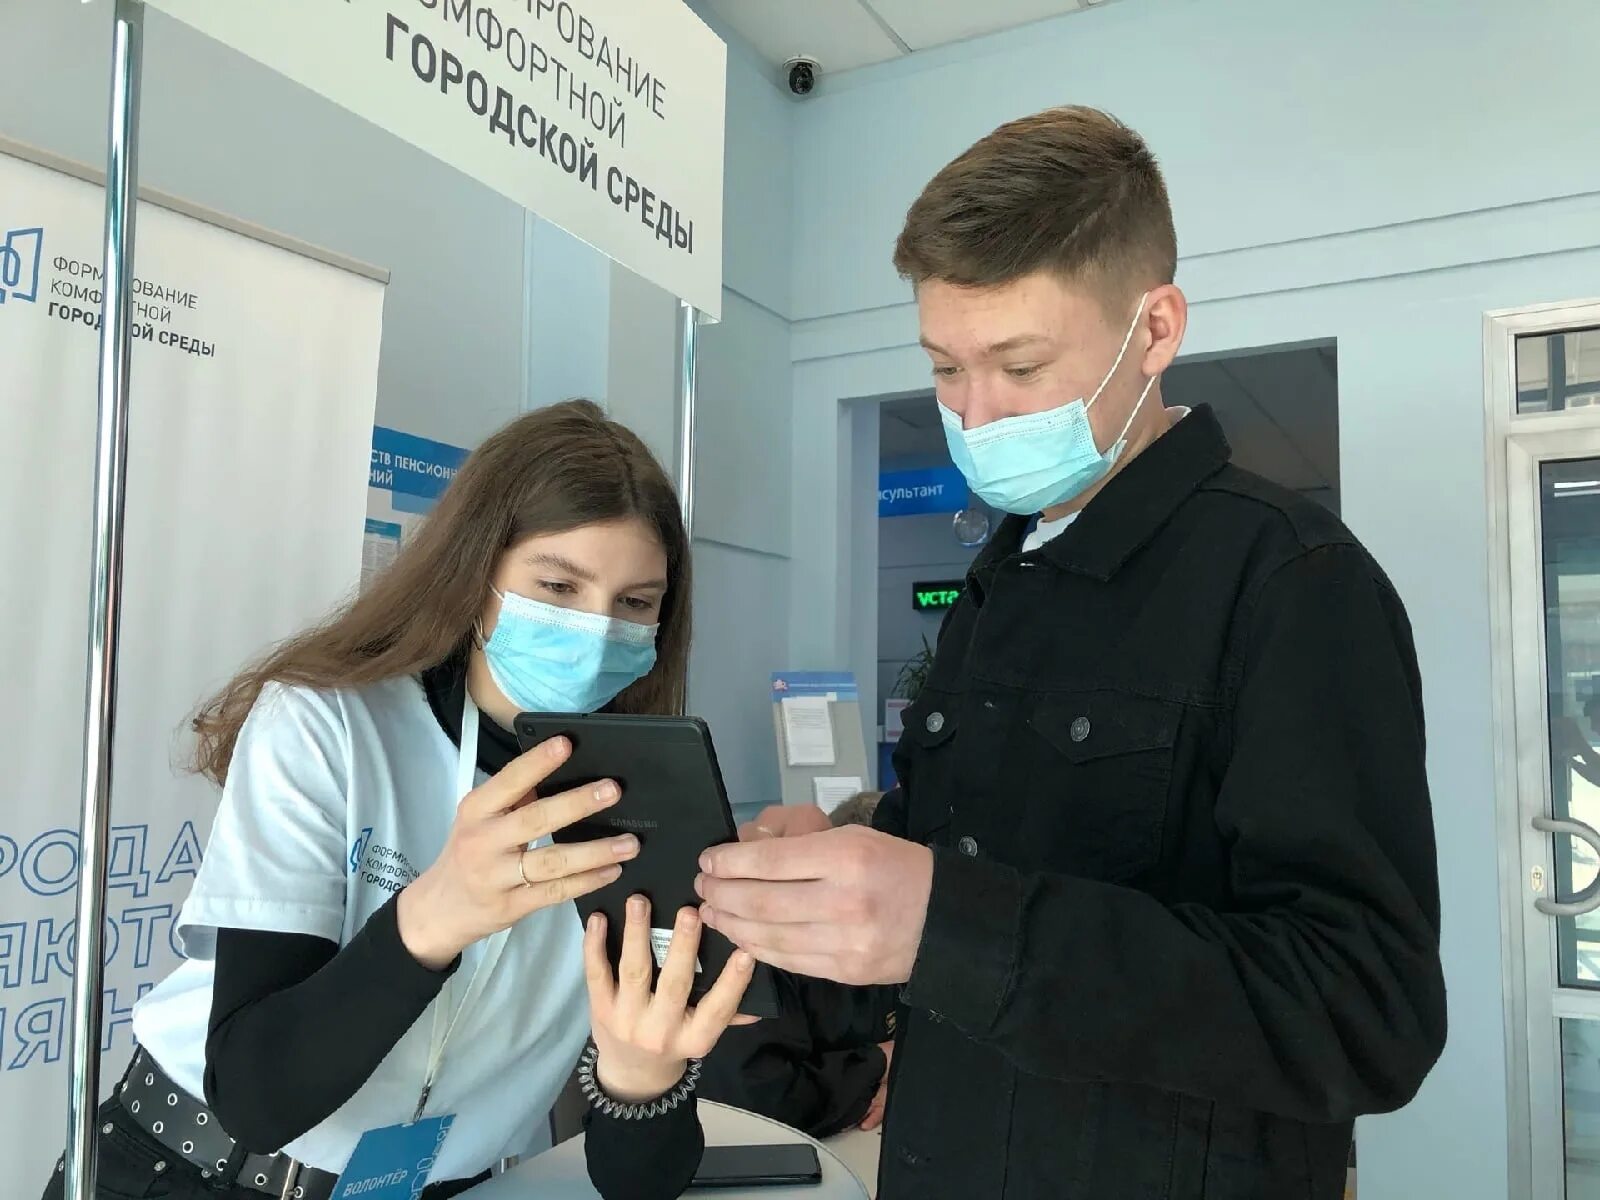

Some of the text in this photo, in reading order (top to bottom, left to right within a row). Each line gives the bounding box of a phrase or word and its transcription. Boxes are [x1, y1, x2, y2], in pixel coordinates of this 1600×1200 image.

[418, 0, 626, 149] МФОРТНОЙ
[386, 12, 693, 254] ГОРОДСКОЙ СРЕДЫ
[50, 278, 171, 323] КОМФНОЙ
[53, 256, 198, 309] ФОРМОВАНИЕ
[159, 331, 215, 357] СРЕДЫ
[366, 858, 412, 883] КОМФОР
[343, 1168, 408, 1198] ВОЛОНТЁР
